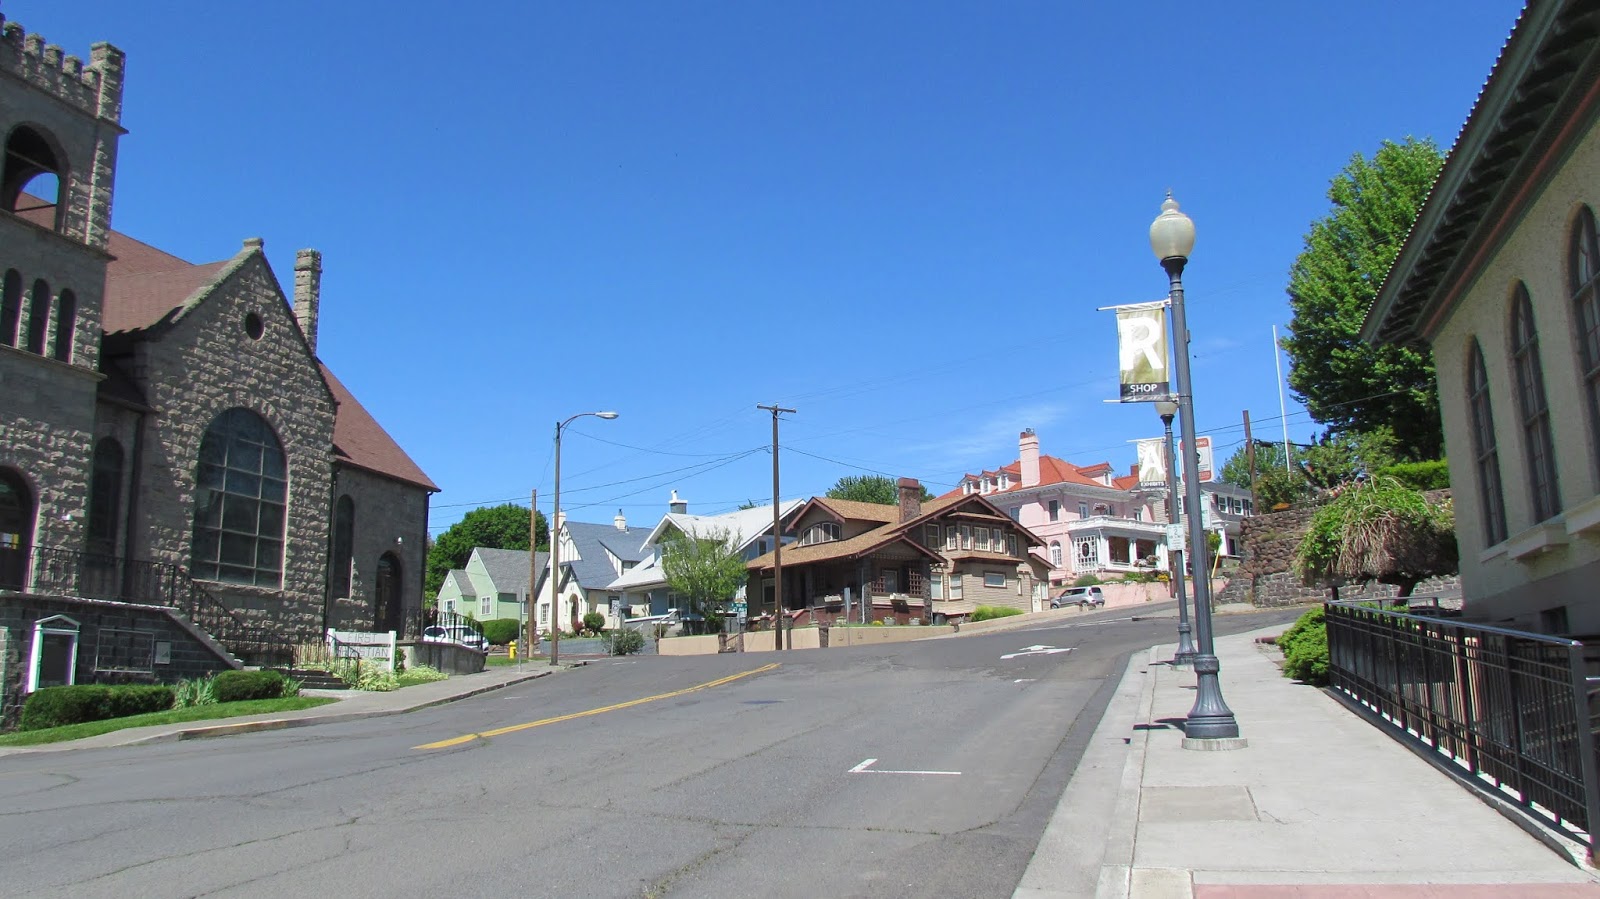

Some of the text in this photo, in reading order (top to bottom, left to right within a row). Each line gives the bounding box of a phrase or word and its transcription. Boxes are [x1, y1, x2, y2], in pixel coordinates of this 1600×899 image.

[1119, 317, 1164, 370] R
[1130, 384, 1157, 392] SHOP
[1139, 445, 1165, 481] A
[347, 633, 377, 643] FIRST
